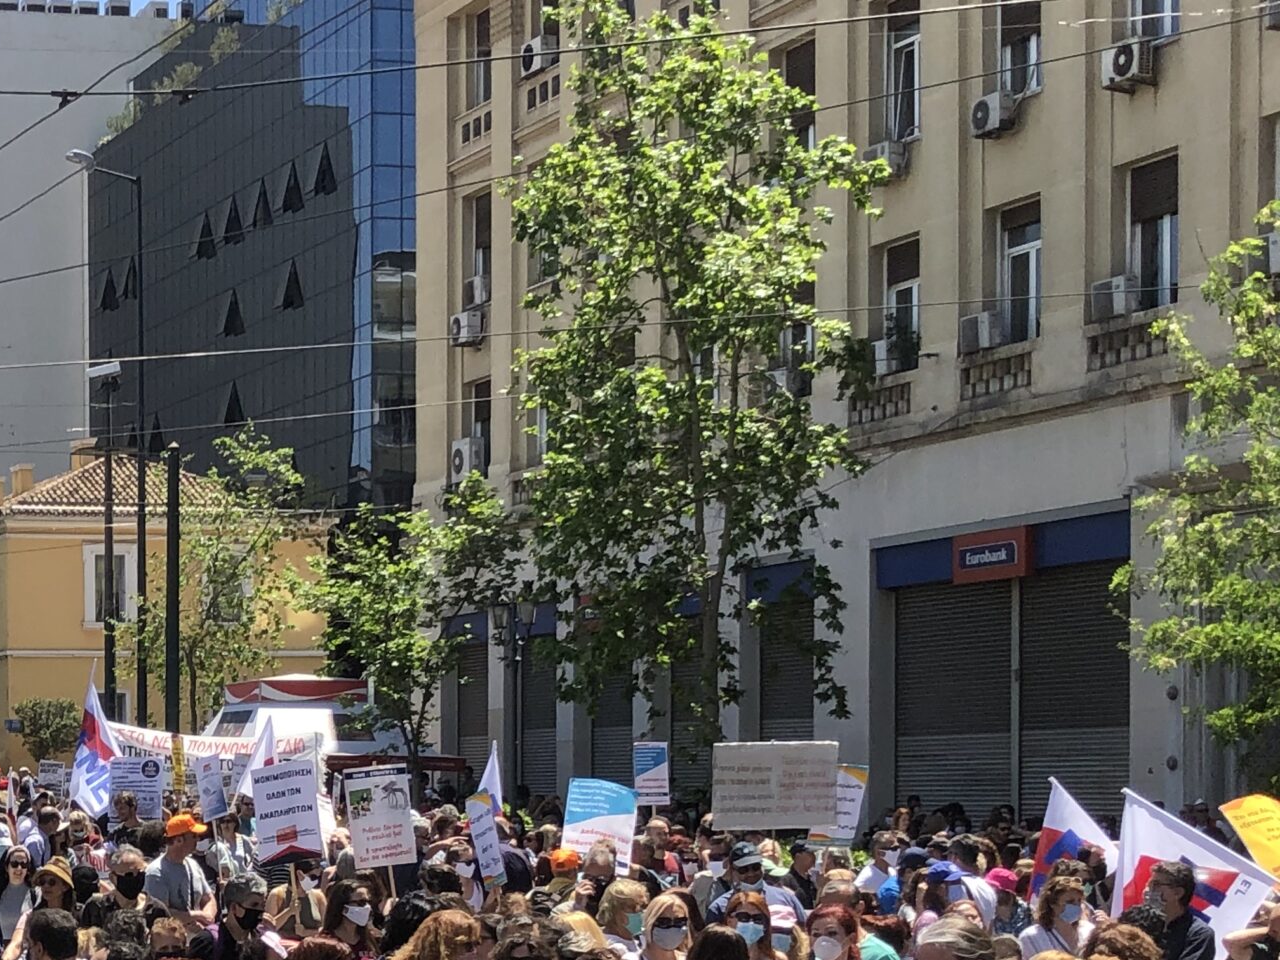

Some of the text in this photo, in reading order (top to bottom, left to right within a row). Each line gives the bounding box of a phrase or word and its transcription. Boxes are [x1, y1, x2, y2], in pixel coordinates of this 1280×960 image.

[965, 548, 1008, 566] Eurobank
[254, 768, 312, 784] ΜΟΝΙΜΟΠΟΙΗΣΗ
[259, 803, 313, 820] ΑΝΑΠΛΗΡΩΤΩΝ
